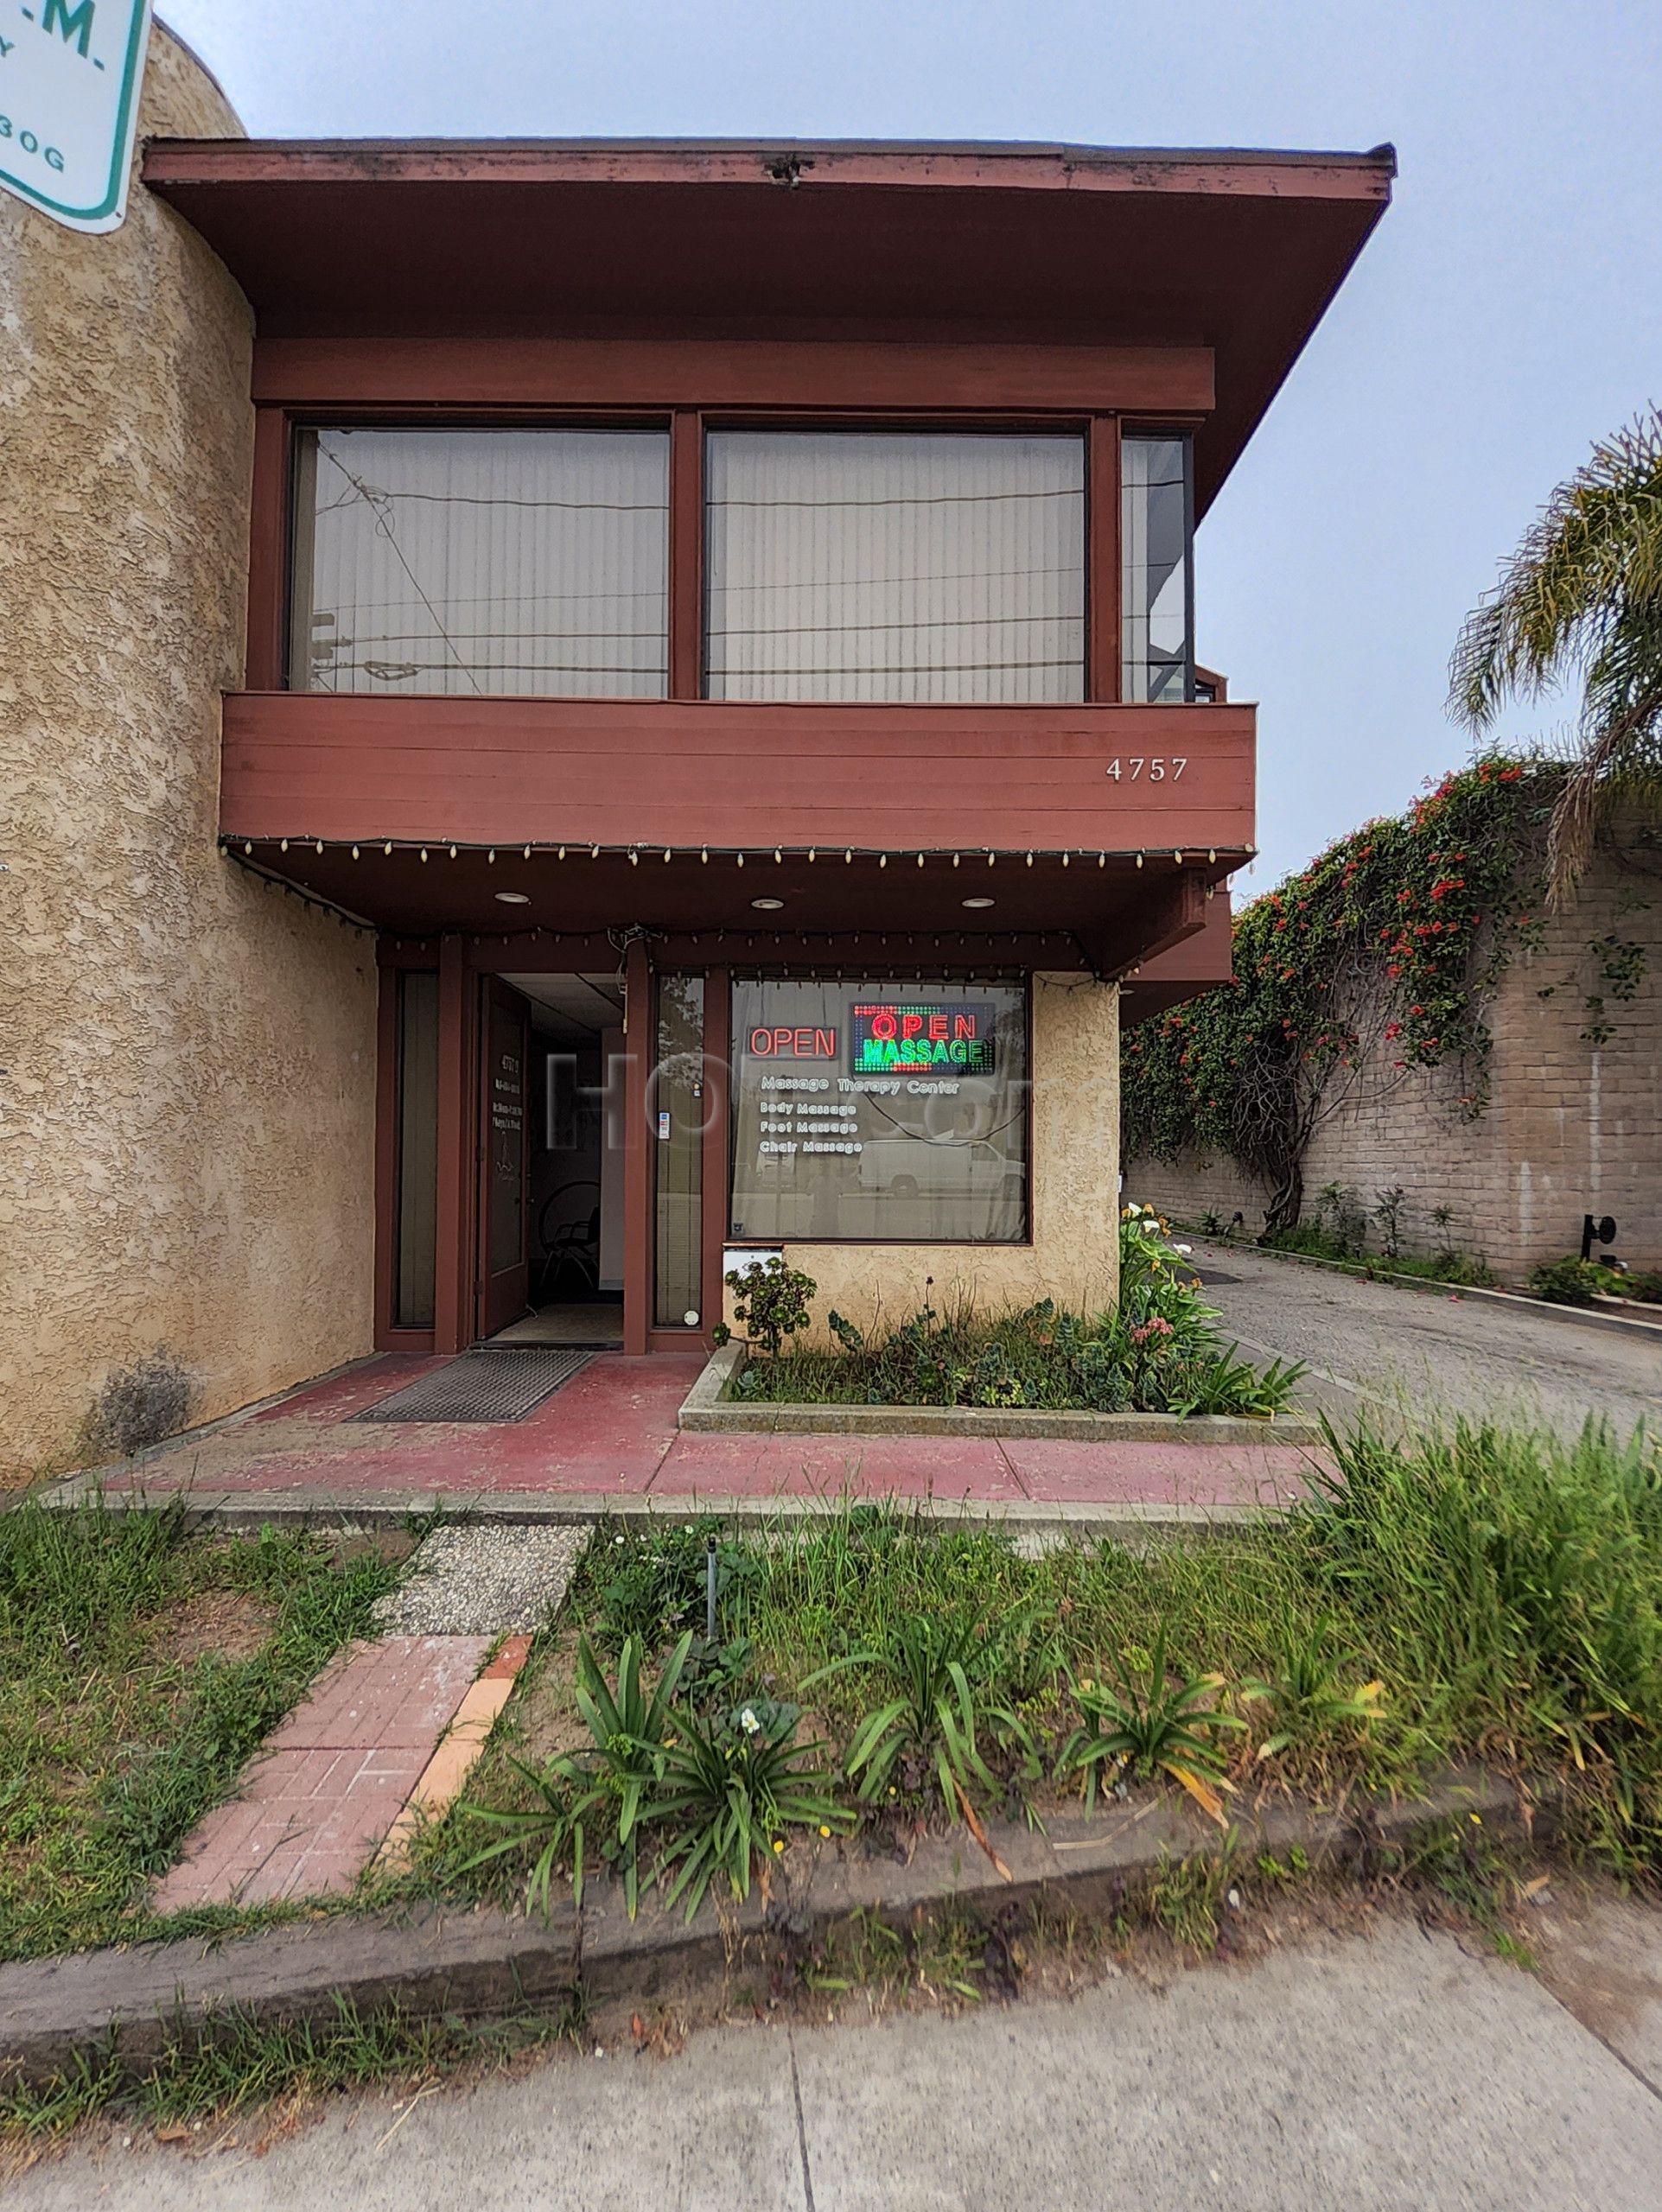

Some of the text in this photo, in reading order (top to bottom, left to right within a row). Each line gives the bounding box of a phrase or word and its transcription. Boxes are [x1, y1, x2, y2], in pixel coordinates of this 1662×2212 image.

[1106, 758, 1188, 781] 4757
[871, 1013, 976, 1040] OPEN
[750, 1028, 836, 1057] OPEN
[863, 1039, 983, 1065] MASSAGE
[761, 1077, 960, 1095] Massage Therapy Center
[760, 1102, 856, 1116] Body Massage
[760, 1122, 858, 1135] Foot Massage
[759, 1141, 863, 1155] Chair Massage
